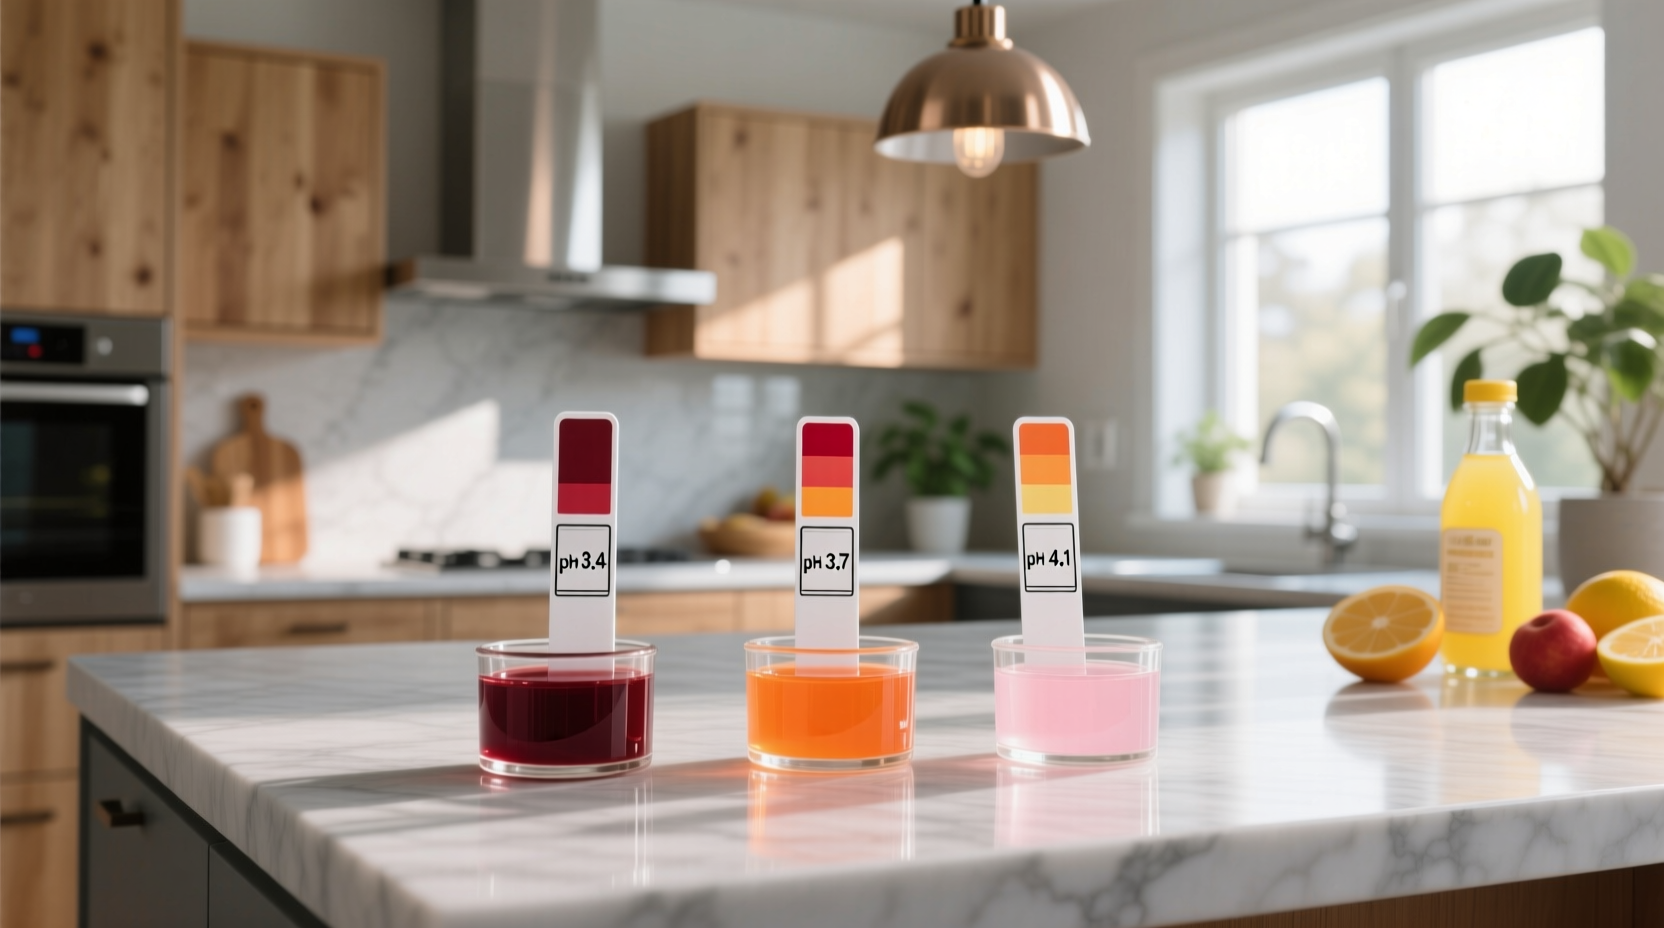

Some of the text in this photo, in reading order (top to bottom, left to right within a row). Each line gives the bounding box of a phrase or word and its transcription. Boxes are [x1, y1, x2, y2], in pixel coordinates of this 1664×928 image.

[581, 551, 607, 570] 3.4
[803, 552, 850, 574] pH 3.7
[1027, 549, 1070, 570] pH 4.1
